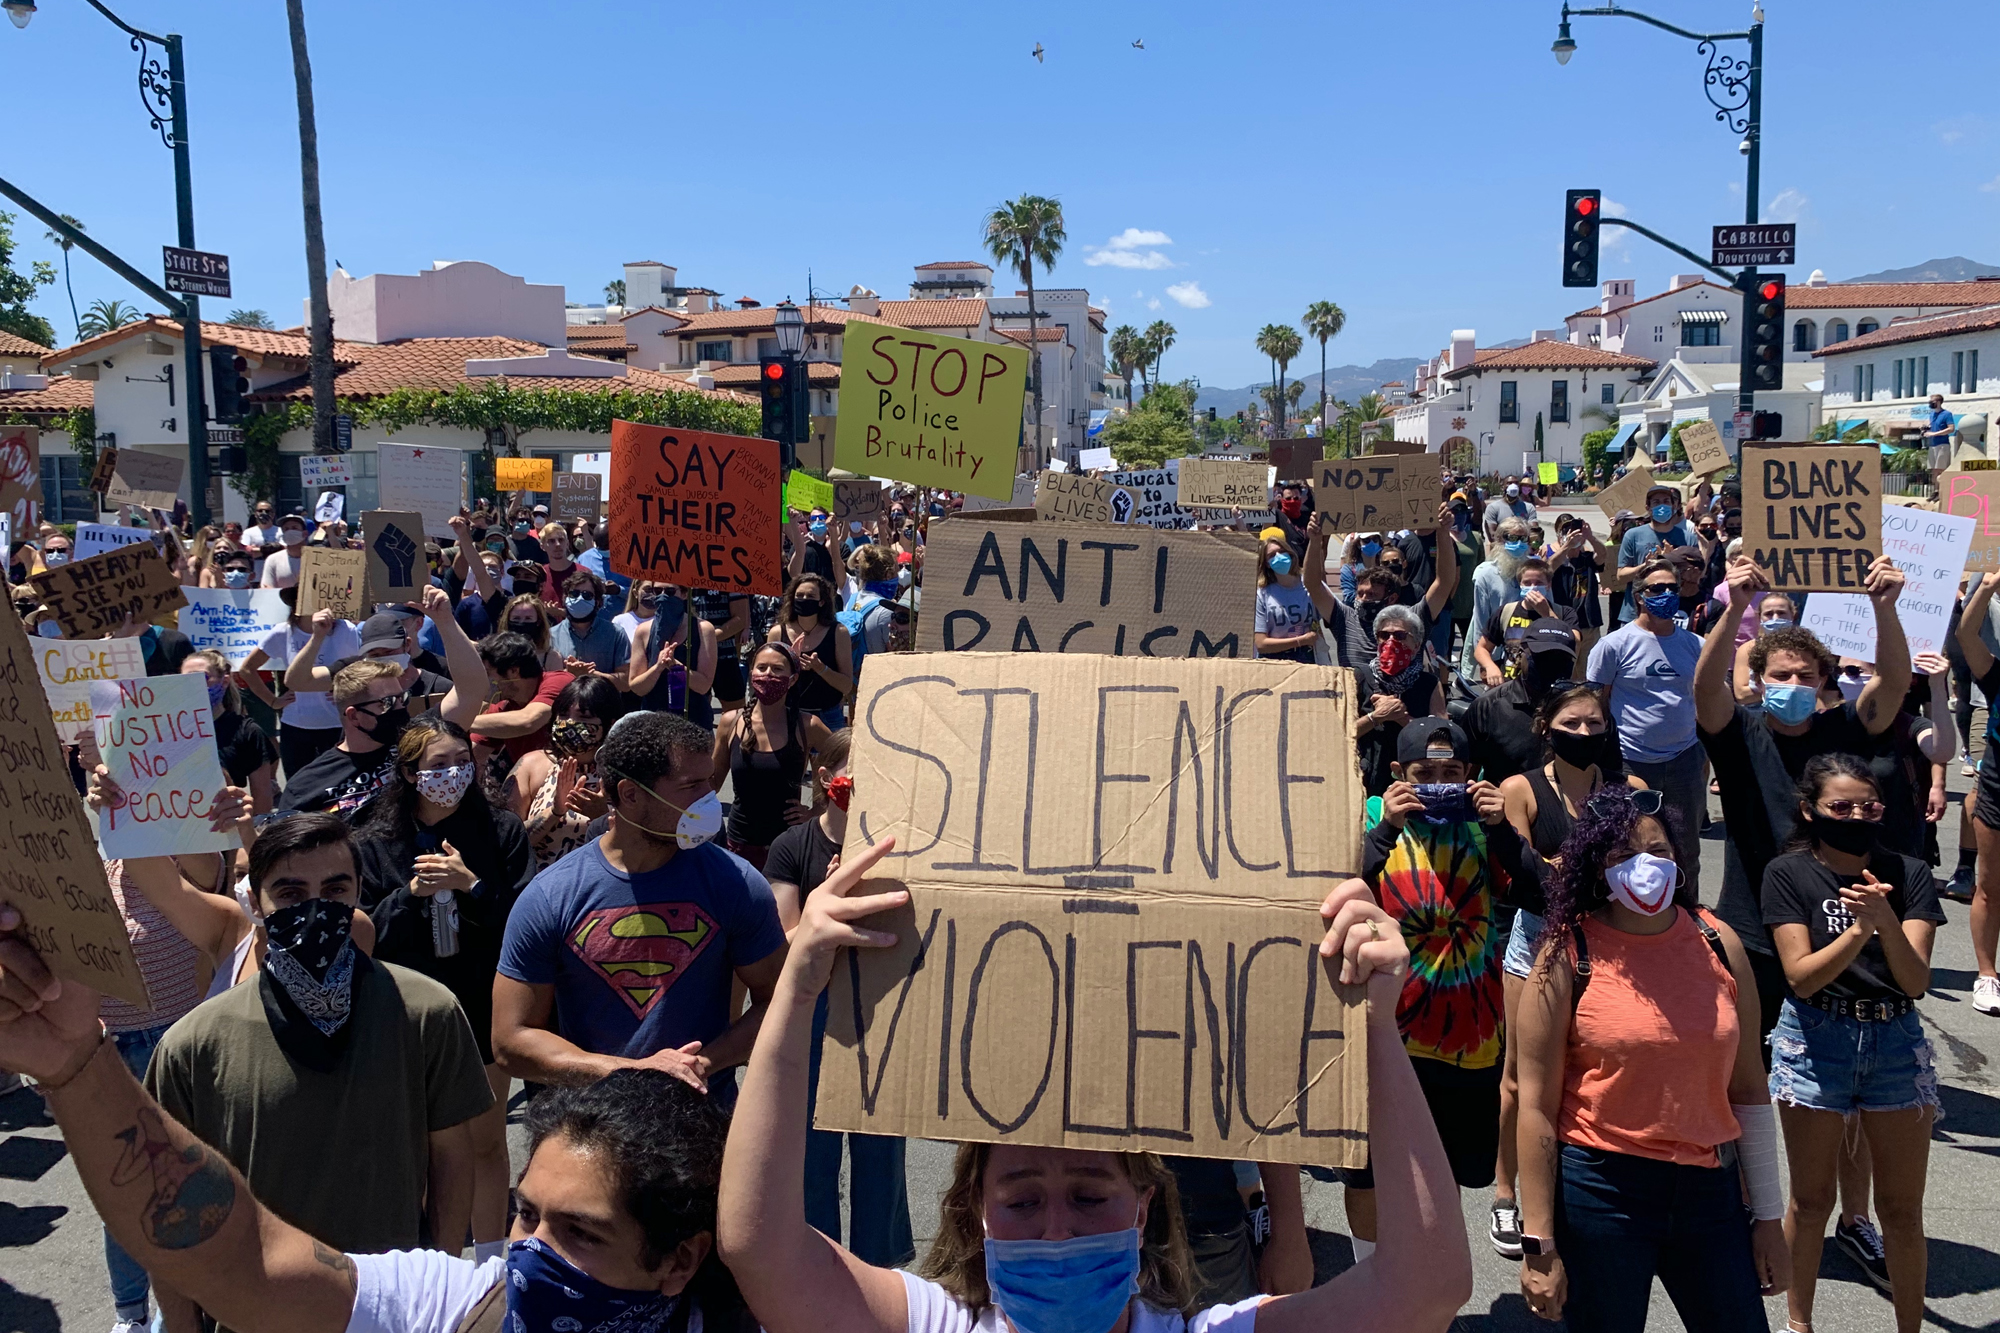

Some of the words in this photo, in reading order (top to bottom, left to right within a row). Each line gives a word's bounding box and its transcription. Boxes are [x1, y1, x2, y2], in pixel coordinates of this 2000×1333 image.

[1718, 229, 1790, 245] CABRILLO
[165, 250, 198, 272] STATE
[202, 256, 216, 274] ST
[1717, 252, 1771, 264] DOWNTOWN
[865, 335, 1008, 405] STOP
[878, 389, 960, 431] Police
[208, 430, 233, 442] STATE
[1682, 423, 1716, 441] CHARGE
[612, 425, 641, 462] GEORGE
[865, 424, 984, 480] Brutality
[302, 456, 320, 465] ONE
[503, 460, 548, 470] BLACK
[616, 443, 642, 474] FLOYD
[655, 436, 736, 491] SAY
[735, 446, 777, 486] BREONNA
[1692, 447, 1722, 464] COPS
[1963, 461, 1997, 471] BLACK
[303, 467, 321, 476] ONE
[506, 471, 546, 481] LIVES
[1184, 461, 1208, 472] ALL
[1216, 462, 1256, 474] LIVES
[1226, 474, 1268, 483] MATTER
[316, 476, 341, 485] RACE
[500, 481, 543, 490] MATTER
[556, 474, 598, 491] END
[732, 461, 768, 497] TAYLOR
[1046, 473, 1106, 502] BLACK
[1113, 471, 1177, 487] Educat
[1183, 485, 1216, 494] UNTIL
[1224, 484, 1262, 496] BLACK
[1321, 468, 1364, 490] NO
[1365, 467, 1439, 493] Justice
[1763, 459, 1870, 501] BLACK
[557, 491, 596, 505] Systemic
[644, 484, 679, 497] SAMUEL
[686, 489, 720, 500] DUBOSE
[1143, 487, 1162, 503] to
[1191, 493, 1225, 504] LIVES
[1226, 495, 1267, 505] MATTER
[1604, 479, 1649, 515] BLM
[560, 505, 593, 516] Racism
[609, 492, 633, 522] ARBERY
[637, 494, 737, 538] THEIR
[744, 498, 773, 530] TAMIR
[1053, 496, 1108, 522] LIVES
[1361, 504, 1405, 529] Peace
[740, 513, 765, 535] RICE
[1766, 501, 1867, 541] LIVES
[1882, 514, 1919, 532] YOU
[1924, 523, 1960, 543] ARE
[642, 525, 680, 538] WALTER
[692, 532, 727, 544] SCOTT
[1882, 537, 1928, 557] UTRAL
[311, 550, 323, 566] I
[327, 552, 360, 567] Stand
[626, 532, 753, 587] NAMES
[752, 550, 775, 568] ERIC
[1753, 548, 1877, 590] MATTER
[32, 573, 62, 599] I
[66, 554, 132, 589] HEAR
[129, 548, 159, 570] YOU
[320, 569, 341, 580] with
[615, 563, 648, 580] BOTHAM
[649, 568, 673, 582] JEAN
[748, 561, 783, 591] GARNER
[962, 530, 1169, 614] ANTI
[1933, 568, 1952, 580] OF
[48, 598, 71, 620] I
[72, 584, 111, 614] SEE
[113, 573, 146, 598] YOU
[318, 581, 353, 601] BLACK
[687, 576, 729, 591] JORDAN
[733, 583, 762, 595] DAVIS
[62, 618, 85, 638] I
[86, 594, 144, 631] STAND
[190, 601, 259, 617] ANTI-RACISM
[318, 601, 347, 612] LIVES
[1271, 602, 1315, 627] USA
[1843, 602, 1871, 619] THE
[194, 617, 206, 625] IS
[208, 616, 237, 627] HARD
[1810, 613, 1833, 626] OF
[1837, 619, 1862, 635] THE
[191, 634, 224, 646] LET'S
[227, 636, 259, 647] LEARN
[44, 649, 119, 685] Can't
[119, 680, 155, 709] No
[95, 707, 213, 749] JUSTICE
[128, 750, 169, 780] No
[861, 675, 1362, 880] SILENCE
[109, 788, 213, 831] Peace
[847, 907, 1369, 1142] VIOLENCE
